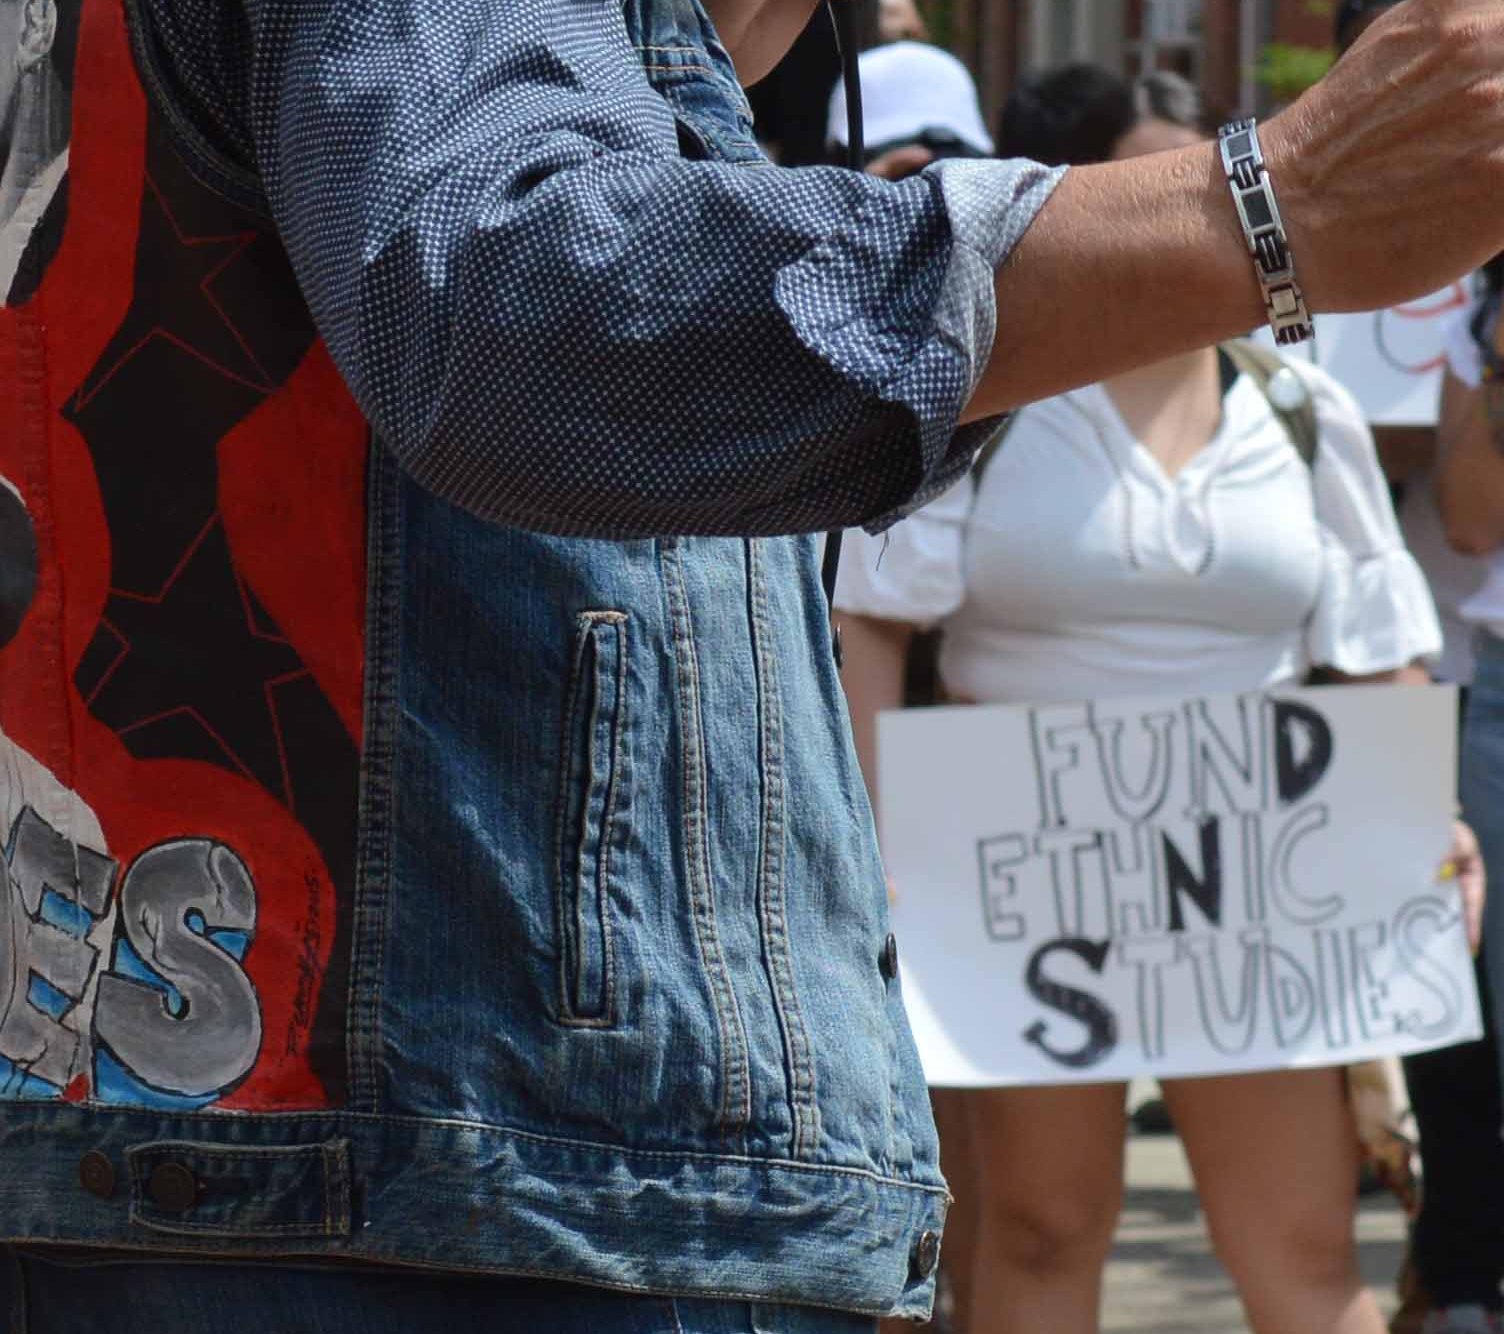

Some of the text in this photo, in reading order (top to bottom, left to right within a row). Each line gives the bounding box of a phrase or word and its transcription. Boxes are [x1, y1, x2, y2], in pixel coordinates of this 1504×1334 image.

[1028, 694, 1334, 828] FUND
[976, 804, 1346, 943] ETHNIC
[1022, 895, 1465, 1069] STUDIES
